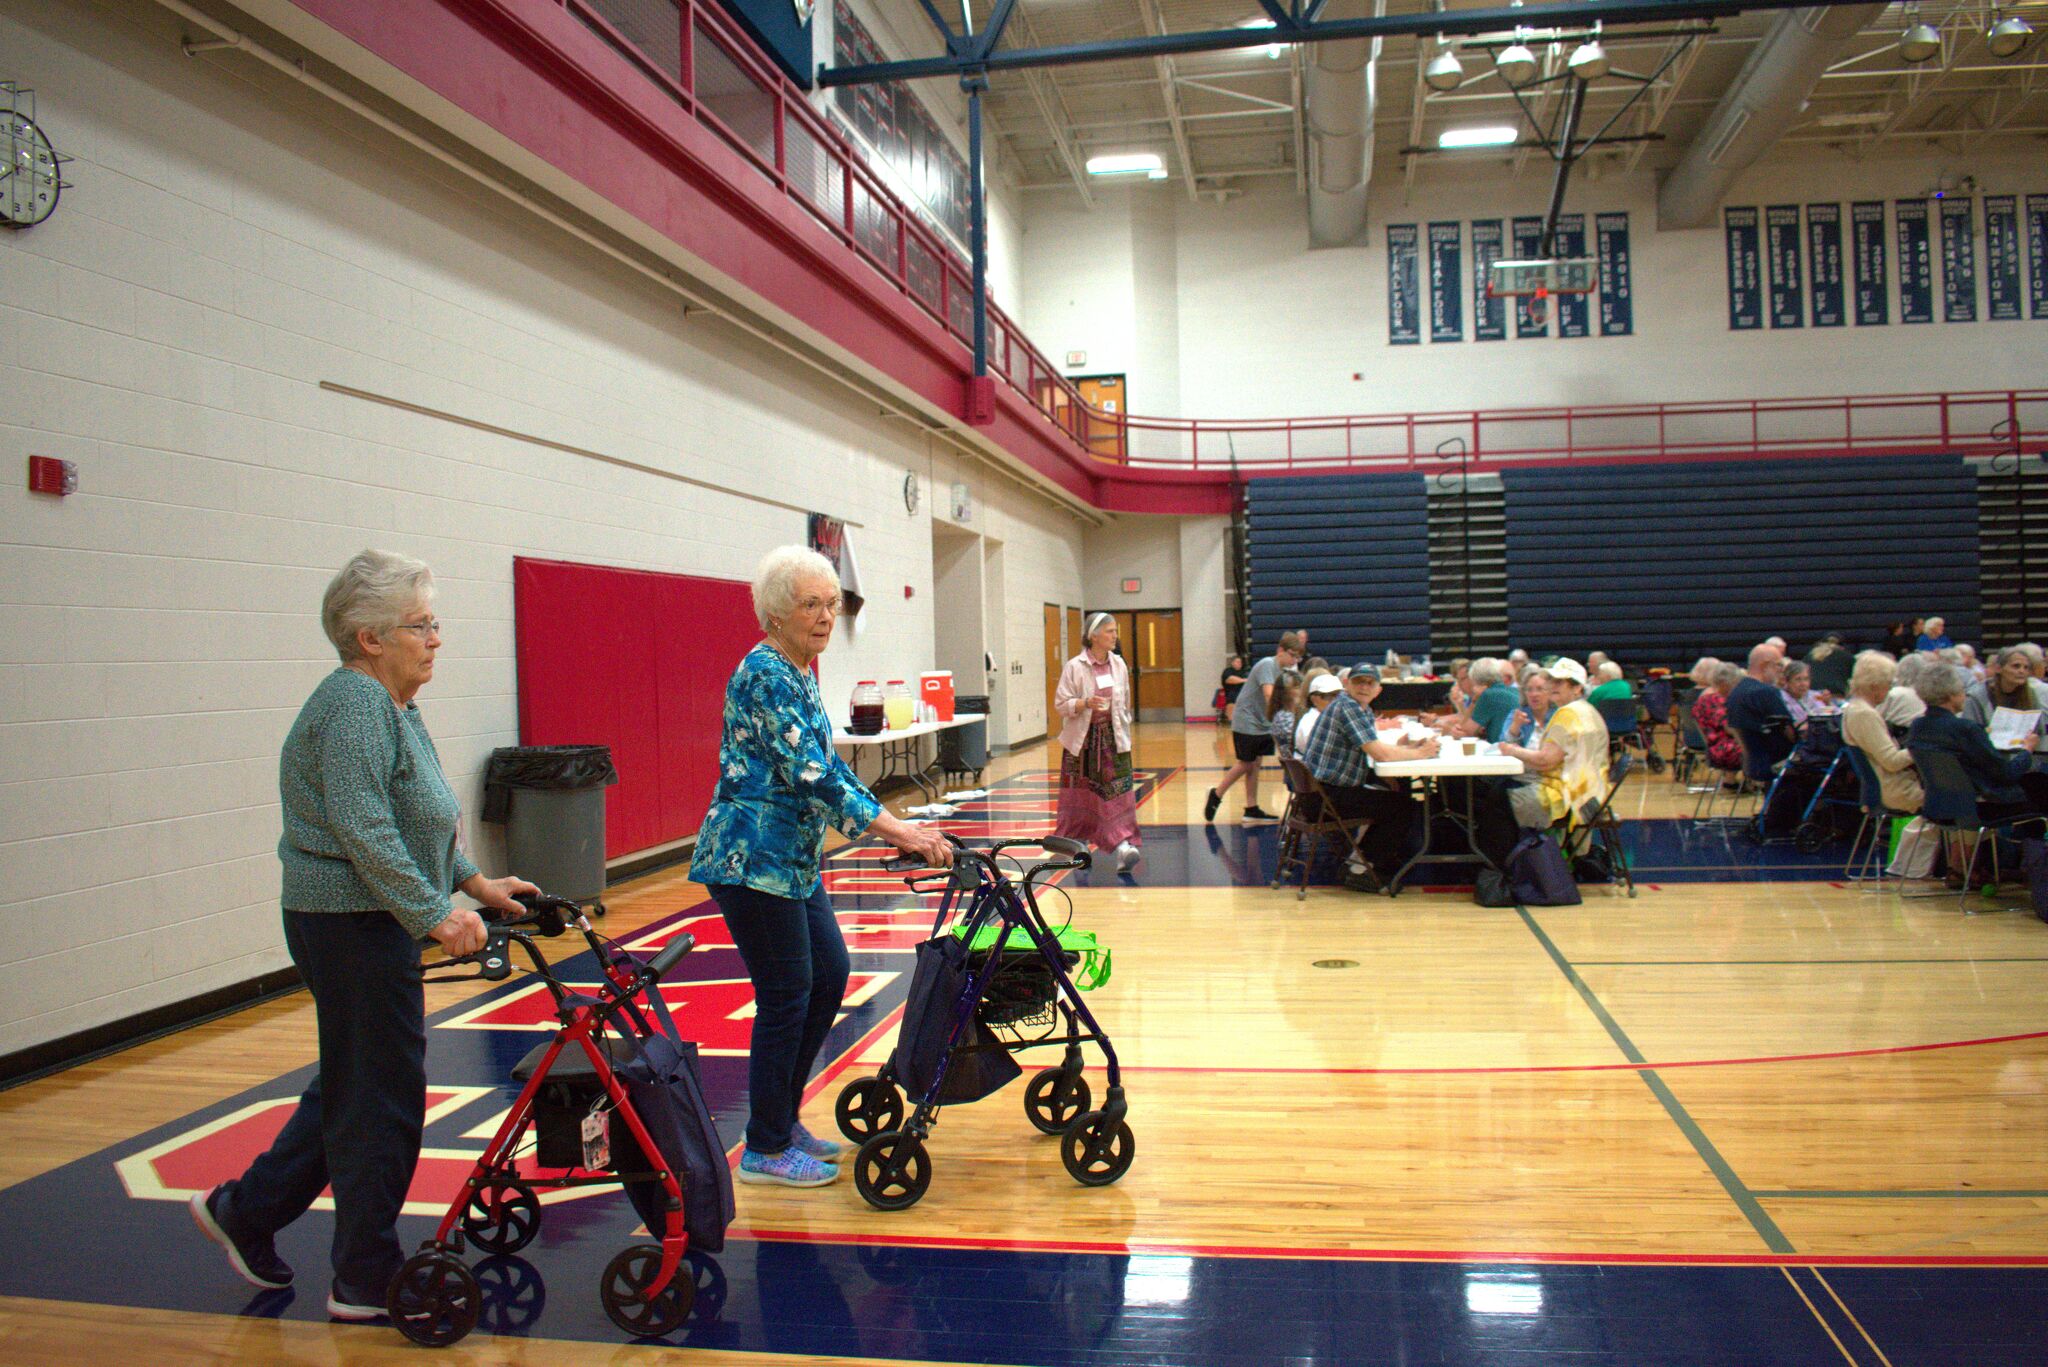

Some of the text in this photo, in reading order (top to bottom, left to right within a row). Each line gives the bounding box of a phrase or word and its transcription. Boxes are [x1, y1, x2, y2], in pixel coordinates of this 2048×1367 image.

[1600, 232, 1612, 293] RUNNER
[1617, 251, 1629, 299] 2010
[1731, 230, 1744, 289] RUNNER
[1771, 226, 1784, 285] RUNNER
[1813, 224, 1826, 312] RUNNER UP
[1858, 222, 1871, 283] RUNNER
[1872, 244, 1882, 285] 2021
[1899, 222, 1912, 315] RUNNER UP
[1917, 240, 1930, 288] 2009
[1944, 218, 1957, 302] CHAMPION
[1989, 215, 2003, 300] CHAMPION
[2031, 215, 2044, 300] CHAMPION
[1433, 241, 1445, 326] FINAL FOUR
[1476, 290, 1487, 326] FOUR
[1734, 292, 1744, 314] UP
[1775, 293, 1785, 314] UP
[1861, 290, 1872, 311] UP
